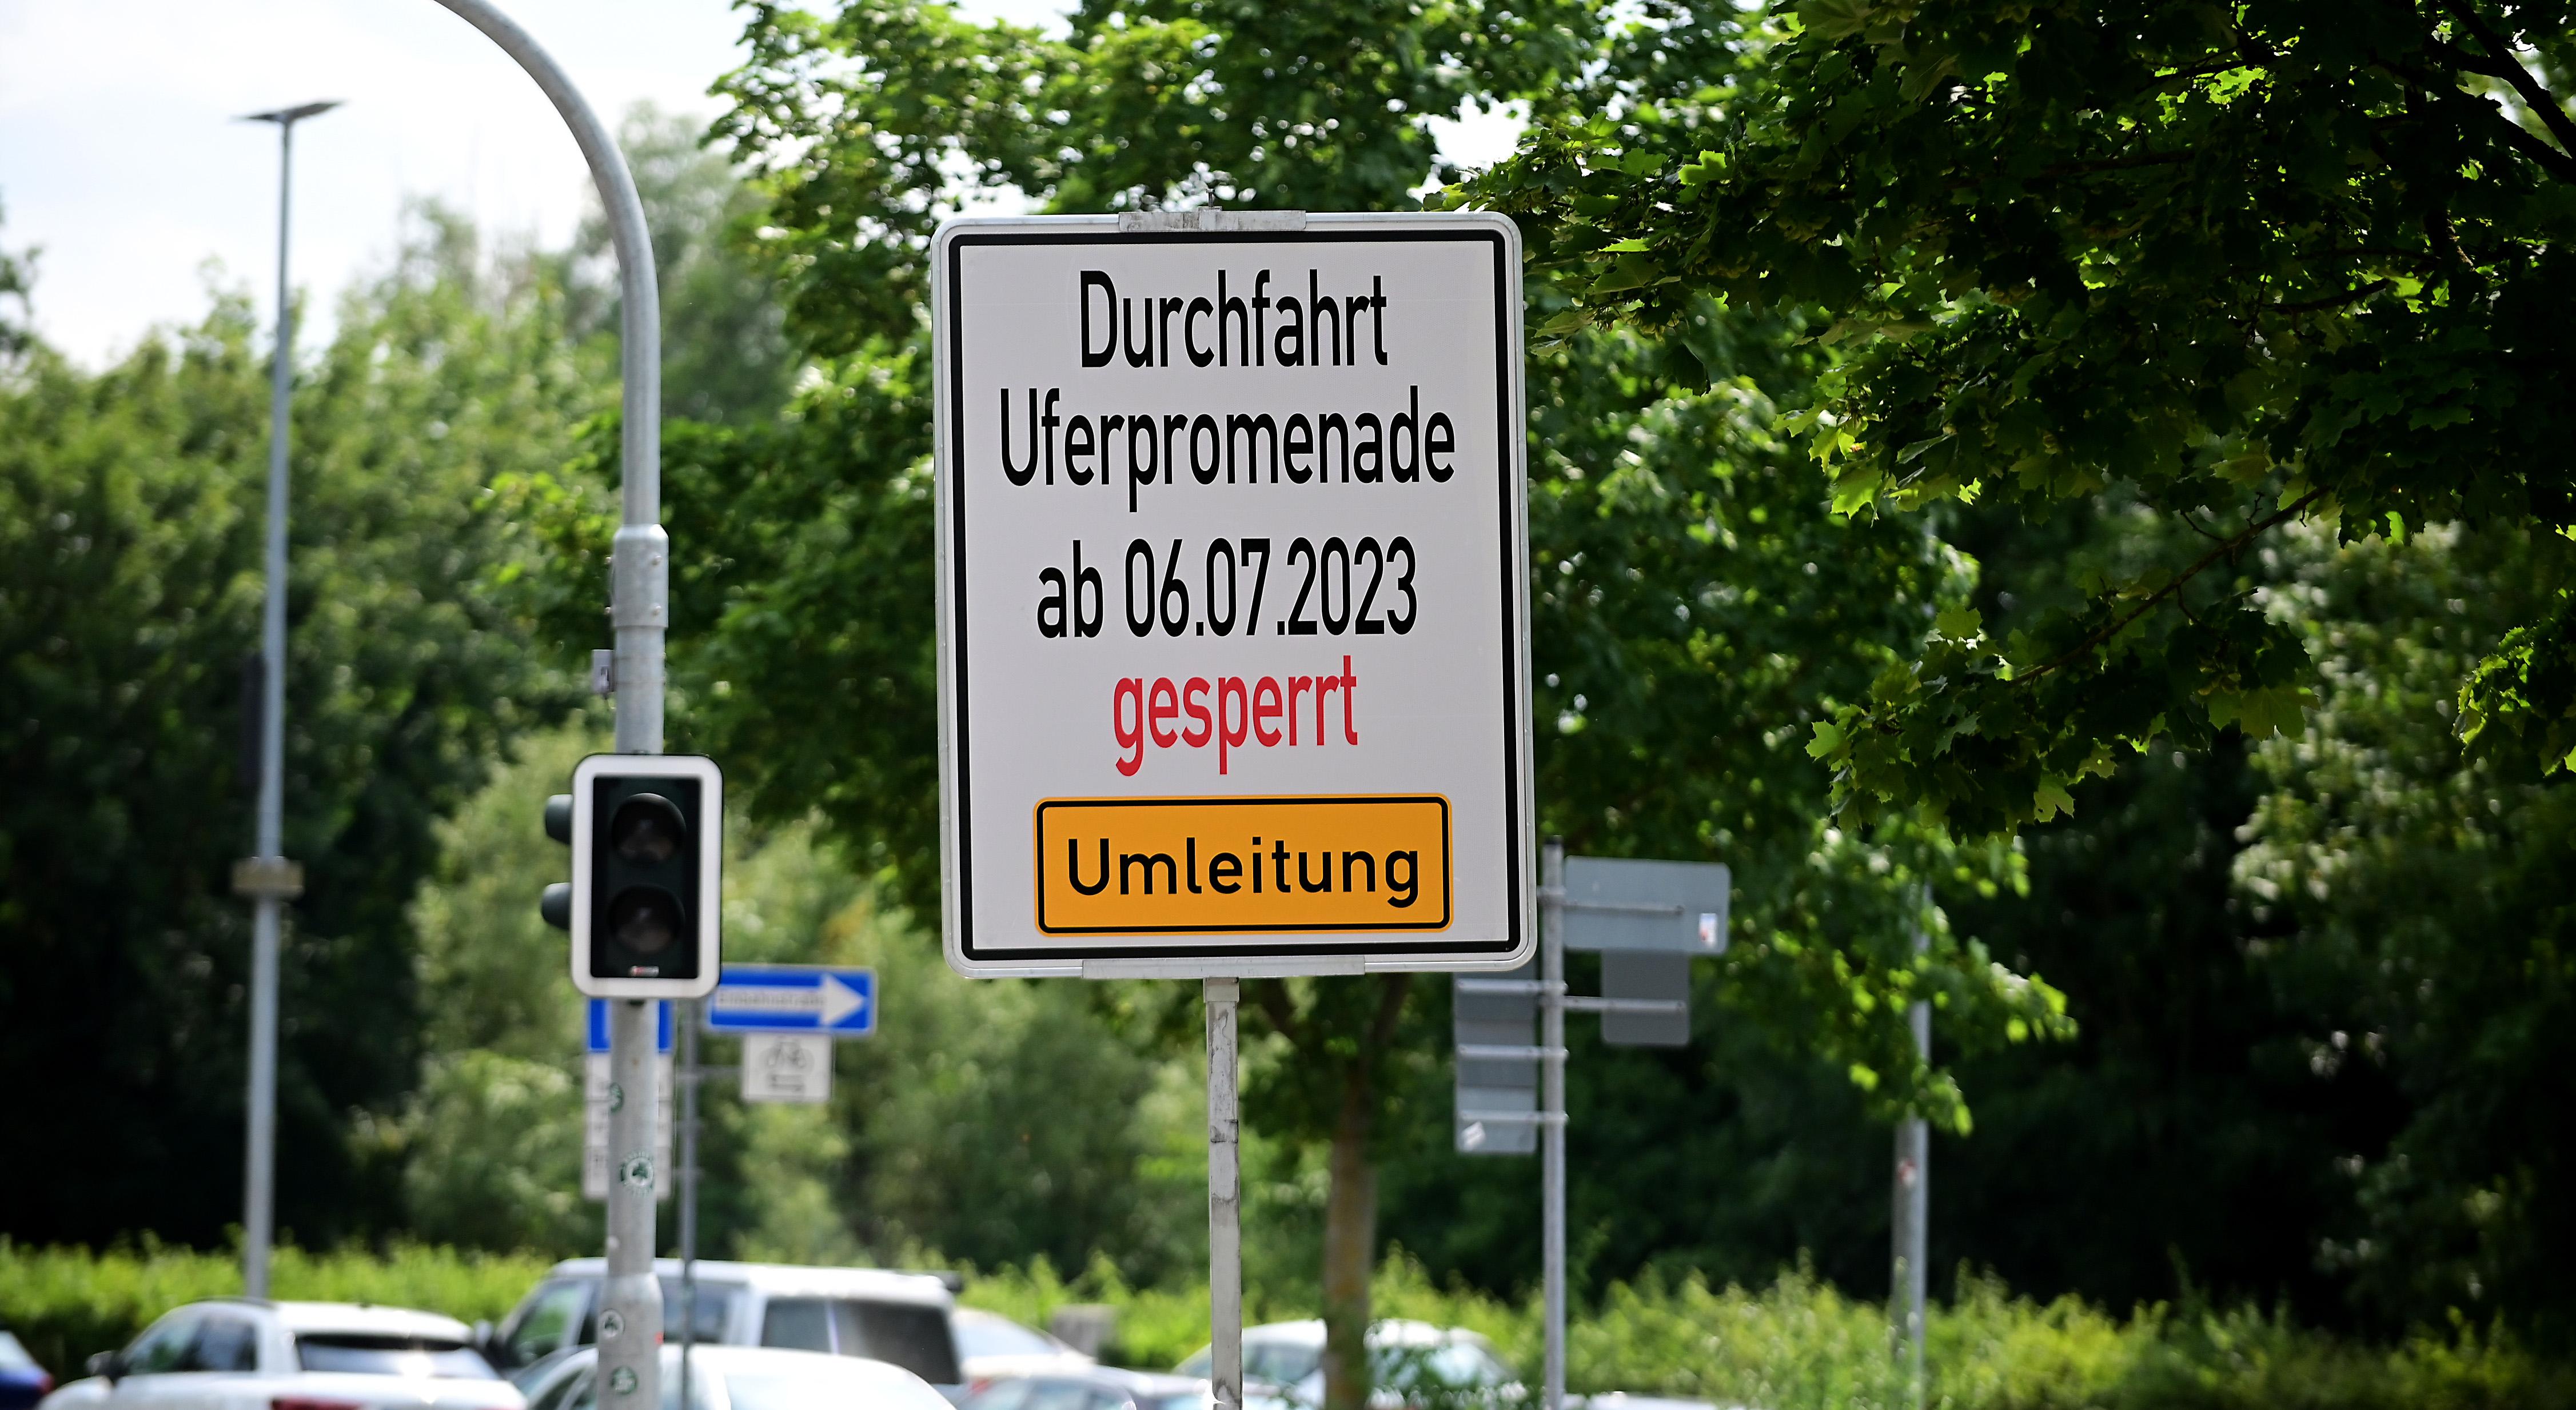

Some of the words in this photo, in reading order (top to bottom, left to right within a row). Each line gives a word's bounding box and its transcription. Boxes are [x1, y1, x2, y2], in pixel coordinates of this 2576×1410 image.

[1080, 269, 1388, 369] Durchfahrt
[1000, 385, 1455, 513] Uferpromenade
[1037, 540, 1103, 638] ab
[1125, 536, 1417, 638] 06.07.2023
[1114, 655, 1358, 777] gesperrt
[1068, 836, 1418, 908] Umleitung
